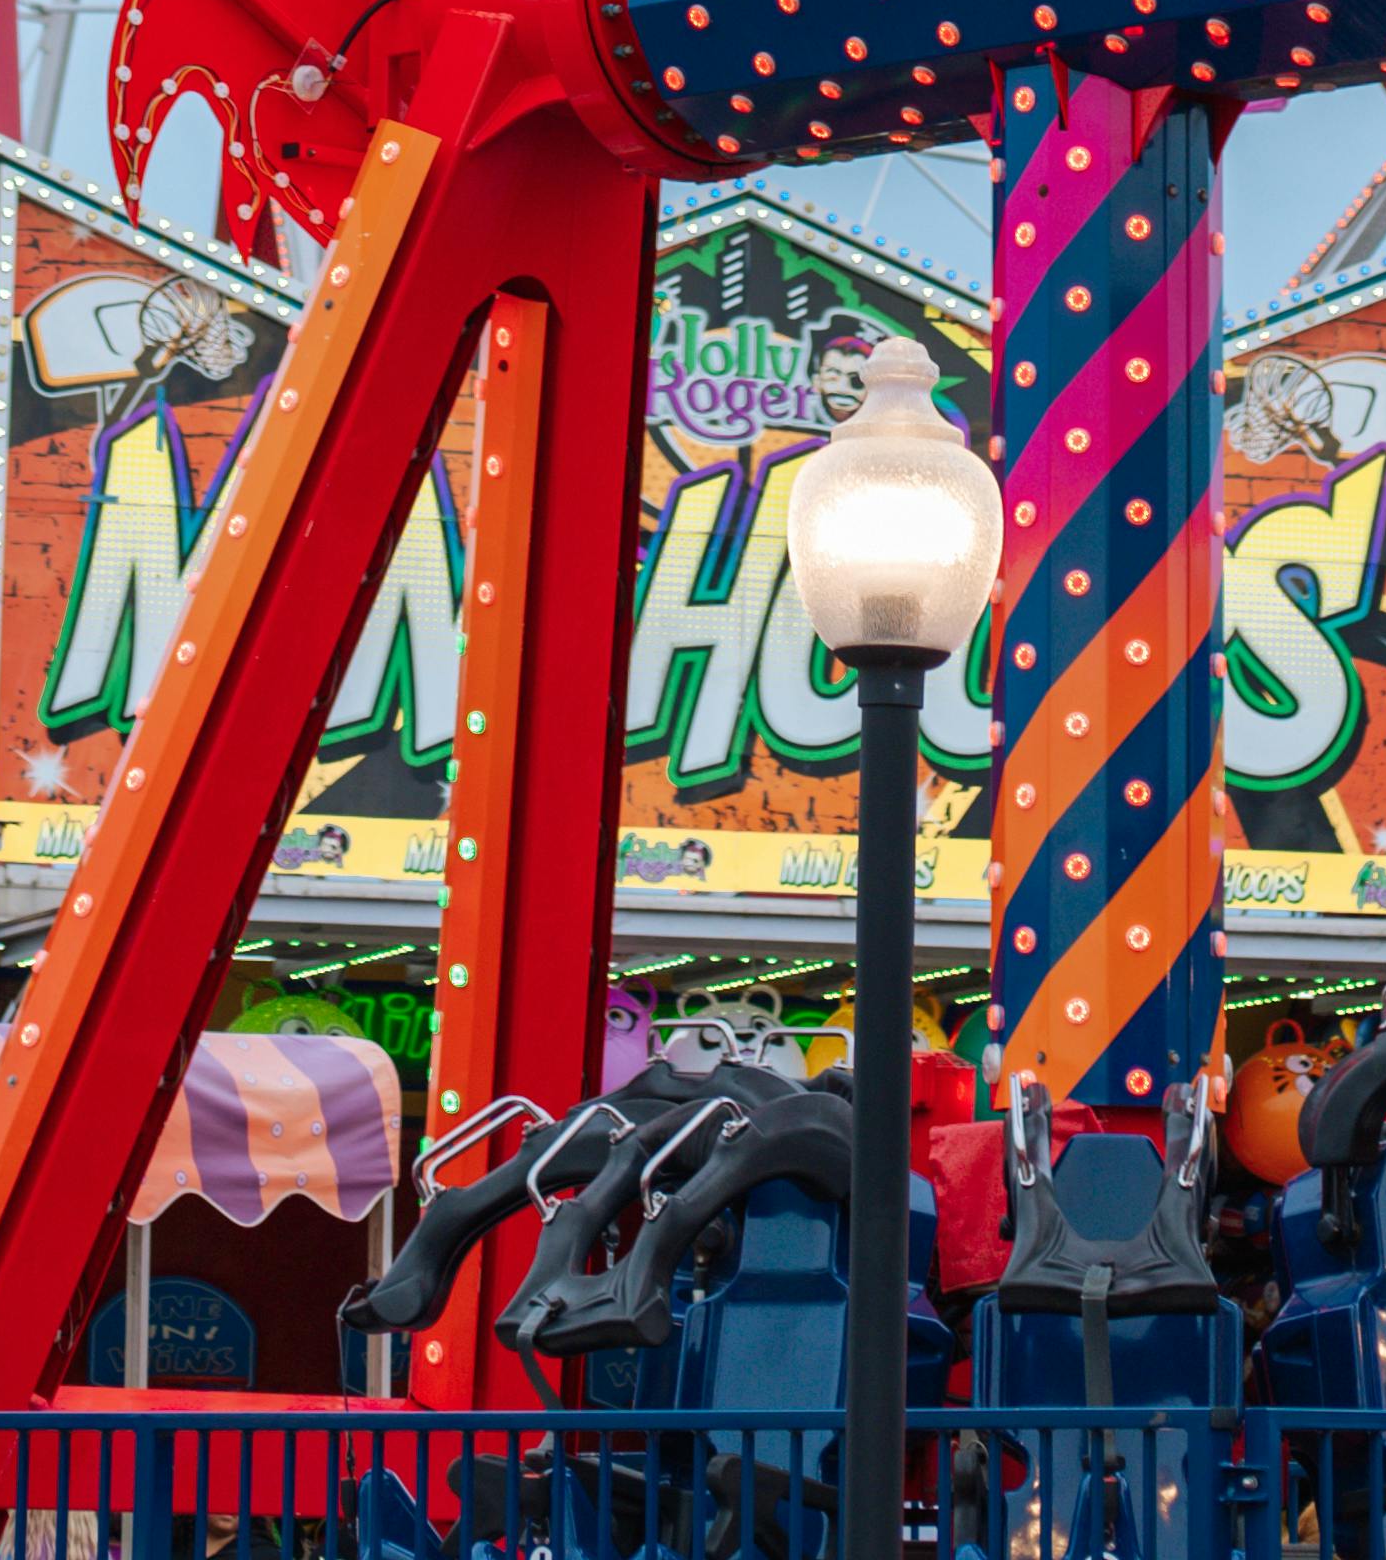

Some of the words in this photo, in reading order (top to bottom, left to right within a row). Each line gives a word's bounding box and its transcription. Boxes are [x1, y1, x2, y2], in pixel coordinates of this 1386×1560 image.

[660, 313, 802, 388] Jolly
[646, 358, 814, 439] Roger
[1224, 861, 1310, 904] HOOPS
